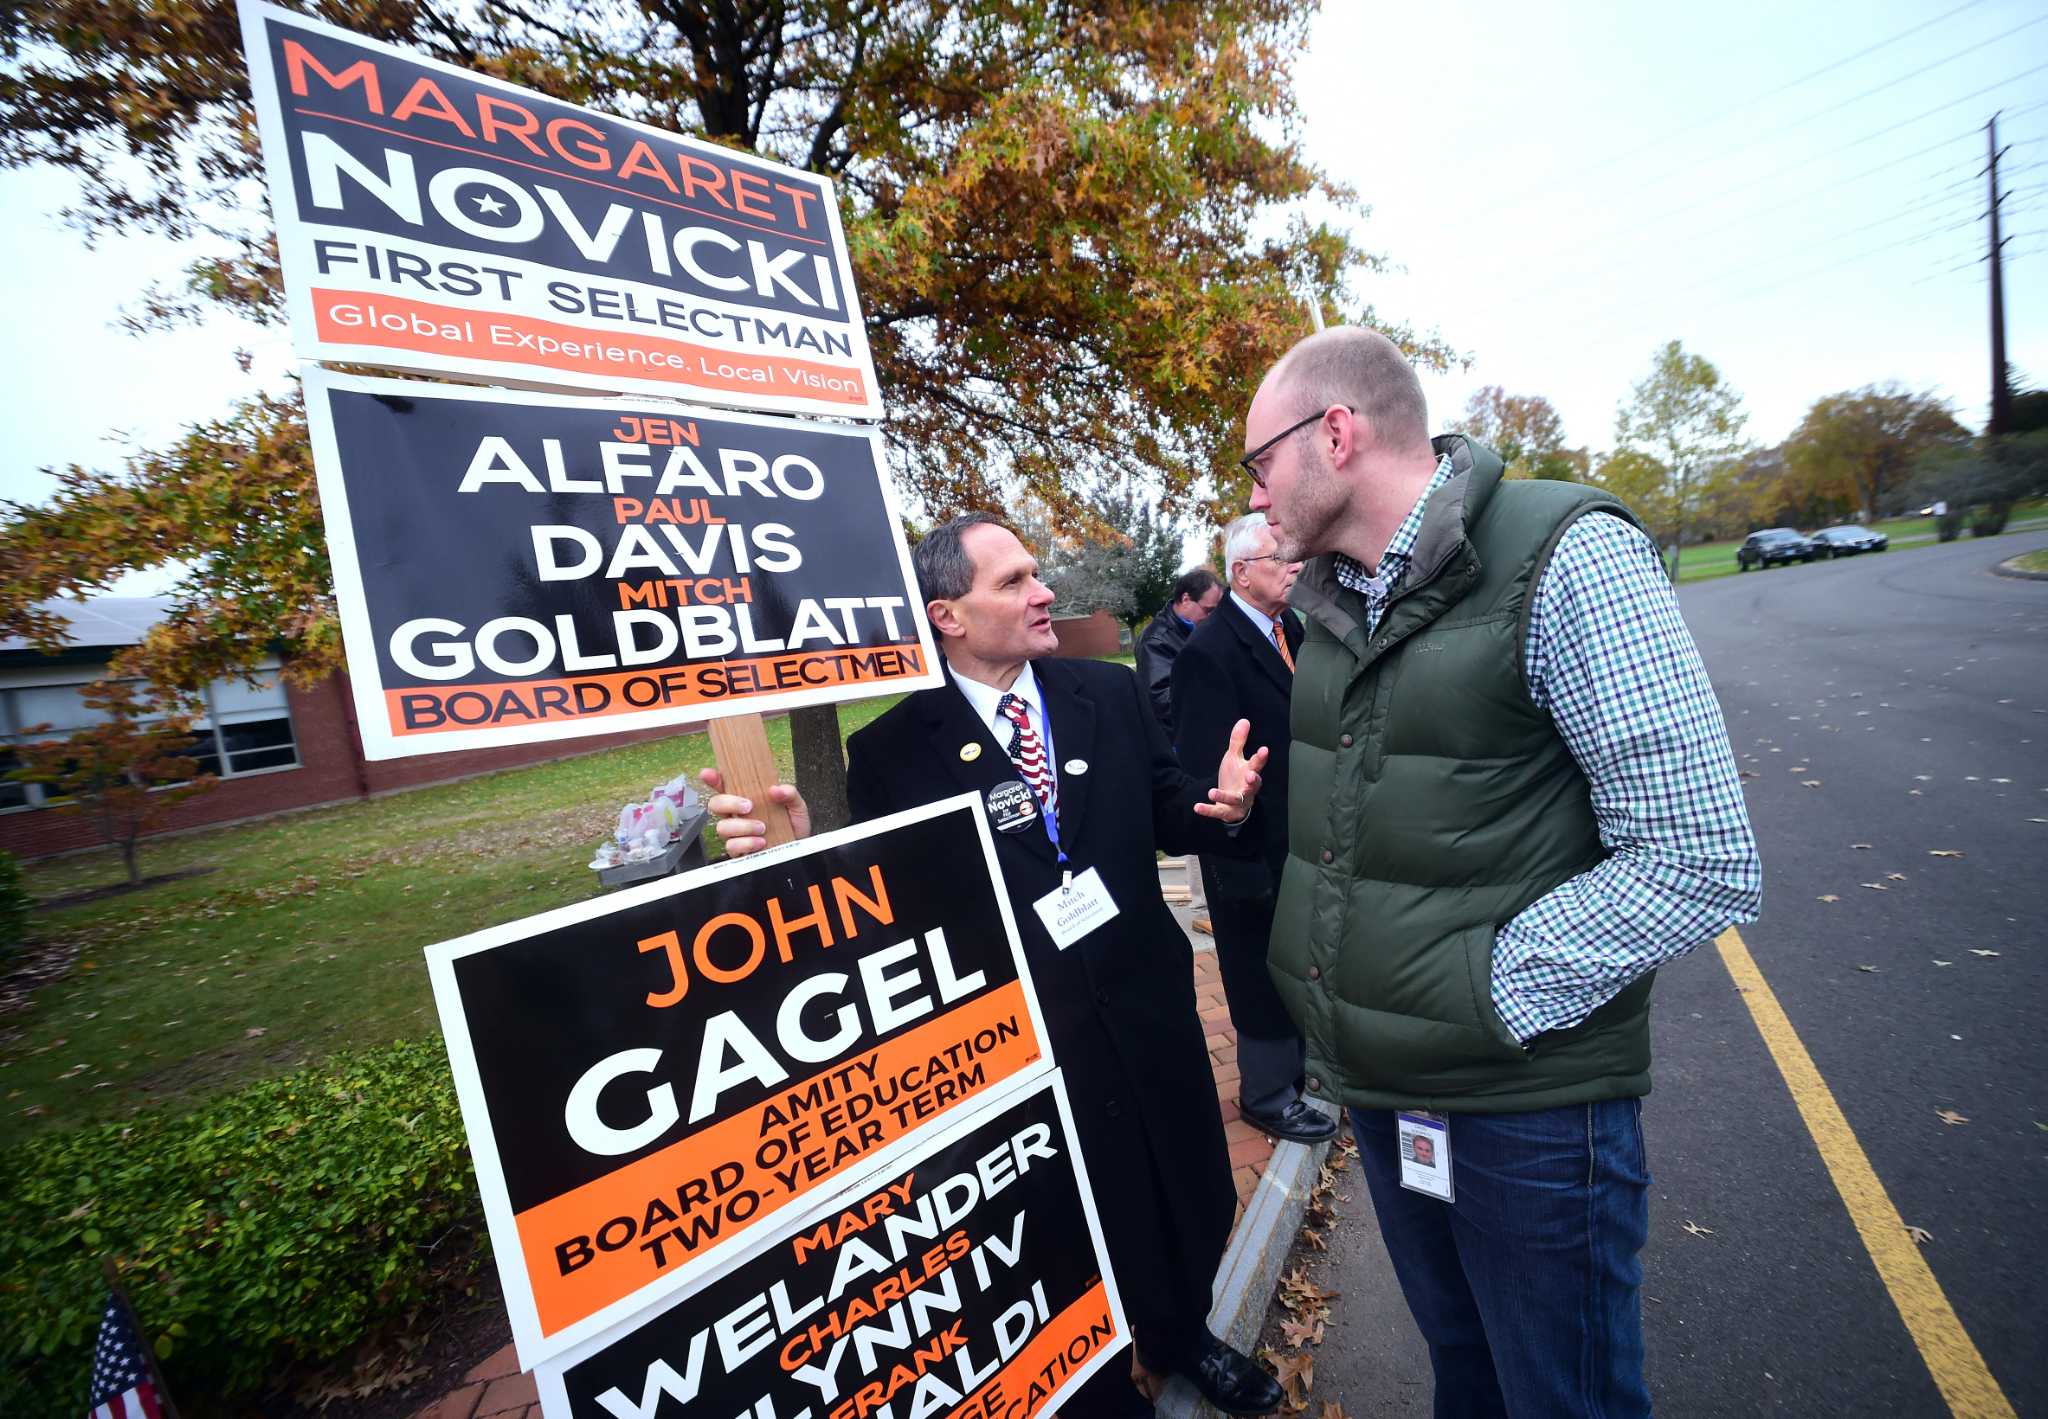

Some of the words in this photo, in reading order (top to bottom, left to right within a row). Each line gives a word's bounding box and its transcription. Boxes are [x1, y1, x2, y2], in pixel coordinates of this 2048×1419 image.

[283, 38, 817, 230] MARGARET
[302, 131, 839, 312] NOVICKI
[313, 239, 523, 301] FIRST
[548, 281, 852, 358] SELECTMAN
[329, 303, 474, 343] Global
[490, 323, 692, 372] Experience.
[700, 356, 776, 384] Local
[782, 365, 860, 393] Vision
[457, 435, 825, 501] ALFARO
[613, 416, 699, 446] JEN
[530, 522, 803, 582] DAVIS
[614, 498, 727, 525] PAUL
[389, 596, 904, 681] GOLDBLATT
[617, 577, 753, 609] MITCH
[402, 682, 612, 729] BOARD
[622, 668, 690, 708] OF
[698, 649, 921, 698] SELECTMEN
[987, 788, 1033, 813] Novicki
[637, 864, 894, 1009] JOHN
[564, 925, 987, 1156] GAGEL
[555, 1159, 745, 1277] BOARD
[755, 1121, 811, 1170] OF
[821, 1015, 1020, 1138] EDUCATION
[760, 1053, 879, 1139] AMITY
[639, 1119, 886, 1270] TWO-YEAR
[889, 1062, 986, 1130] TERM
[594, 1122, 1058, 1419] WELANDER
[793, 1174, 915, 1265] MARY
[735, 1266, 962, 1419] YNN
[970, 1209, 1026, 1292] IV
[779, 1230, 970, 1372] CHARLES
[875, 1279, 1051, 1419] ALDI
[828, 1318, 969, 1419] FRANK
[996, 1312, 1112, 1419] CATION
